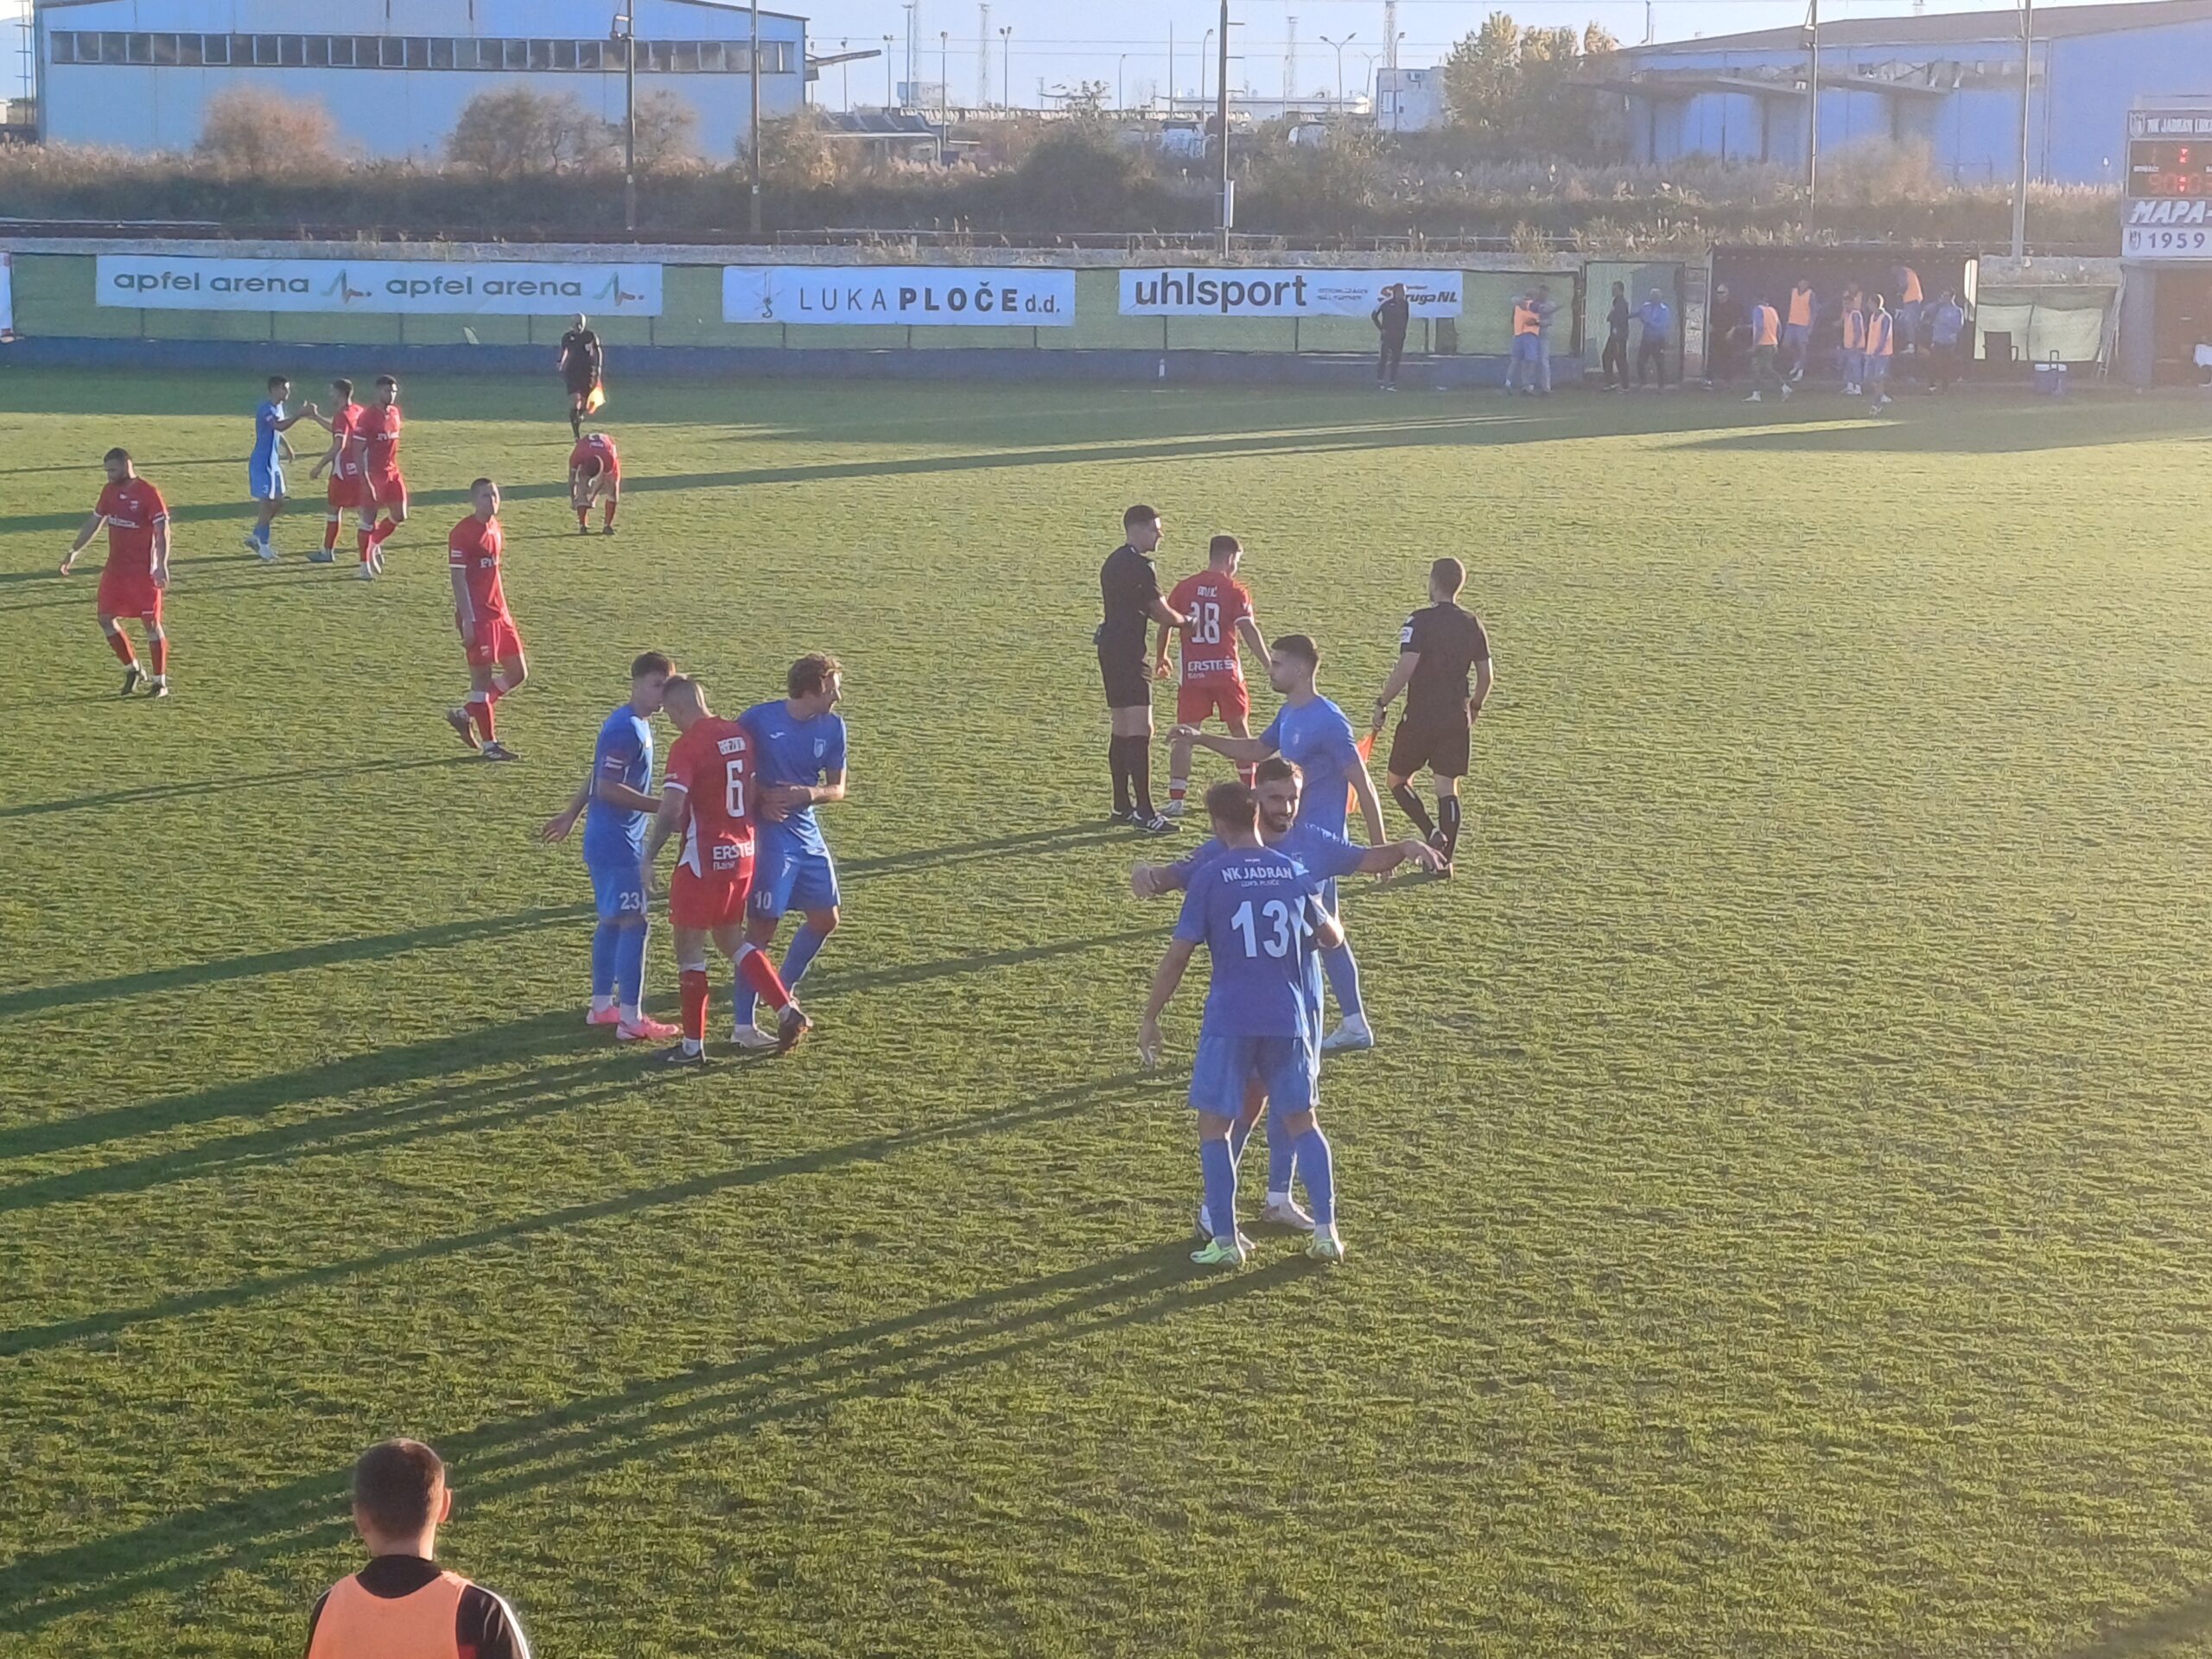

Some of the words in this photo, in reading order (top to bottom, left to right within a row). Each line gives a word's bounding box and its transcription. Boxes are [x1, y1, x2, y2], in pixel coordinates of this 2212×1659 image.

[2148, 232, 2205, 249] 1959
[114, 271, 200, 292] apfel
[210, 276, 308, 292] arena
[385, 276, 473, 297] apfel
[482, 281, 582, 296] arena
[800, 288, 887, 311] LUKA
[899, 282, 1017, 311] PLOČE
[1025, 295, 1060, 313] d.d.
[1135, 272, 1306, 313] uhlsport
[1191, 601, 1220, 644] 18
[727, 760, 745, 817] 6
[1222, 868, 1242, 882] NK
[1244, 866, 1294, 880] JADRAN
[620, 892, 640, 910] 23
[755, 892, 772, 910] 10
[1231, 899, 1289, 958] 13
